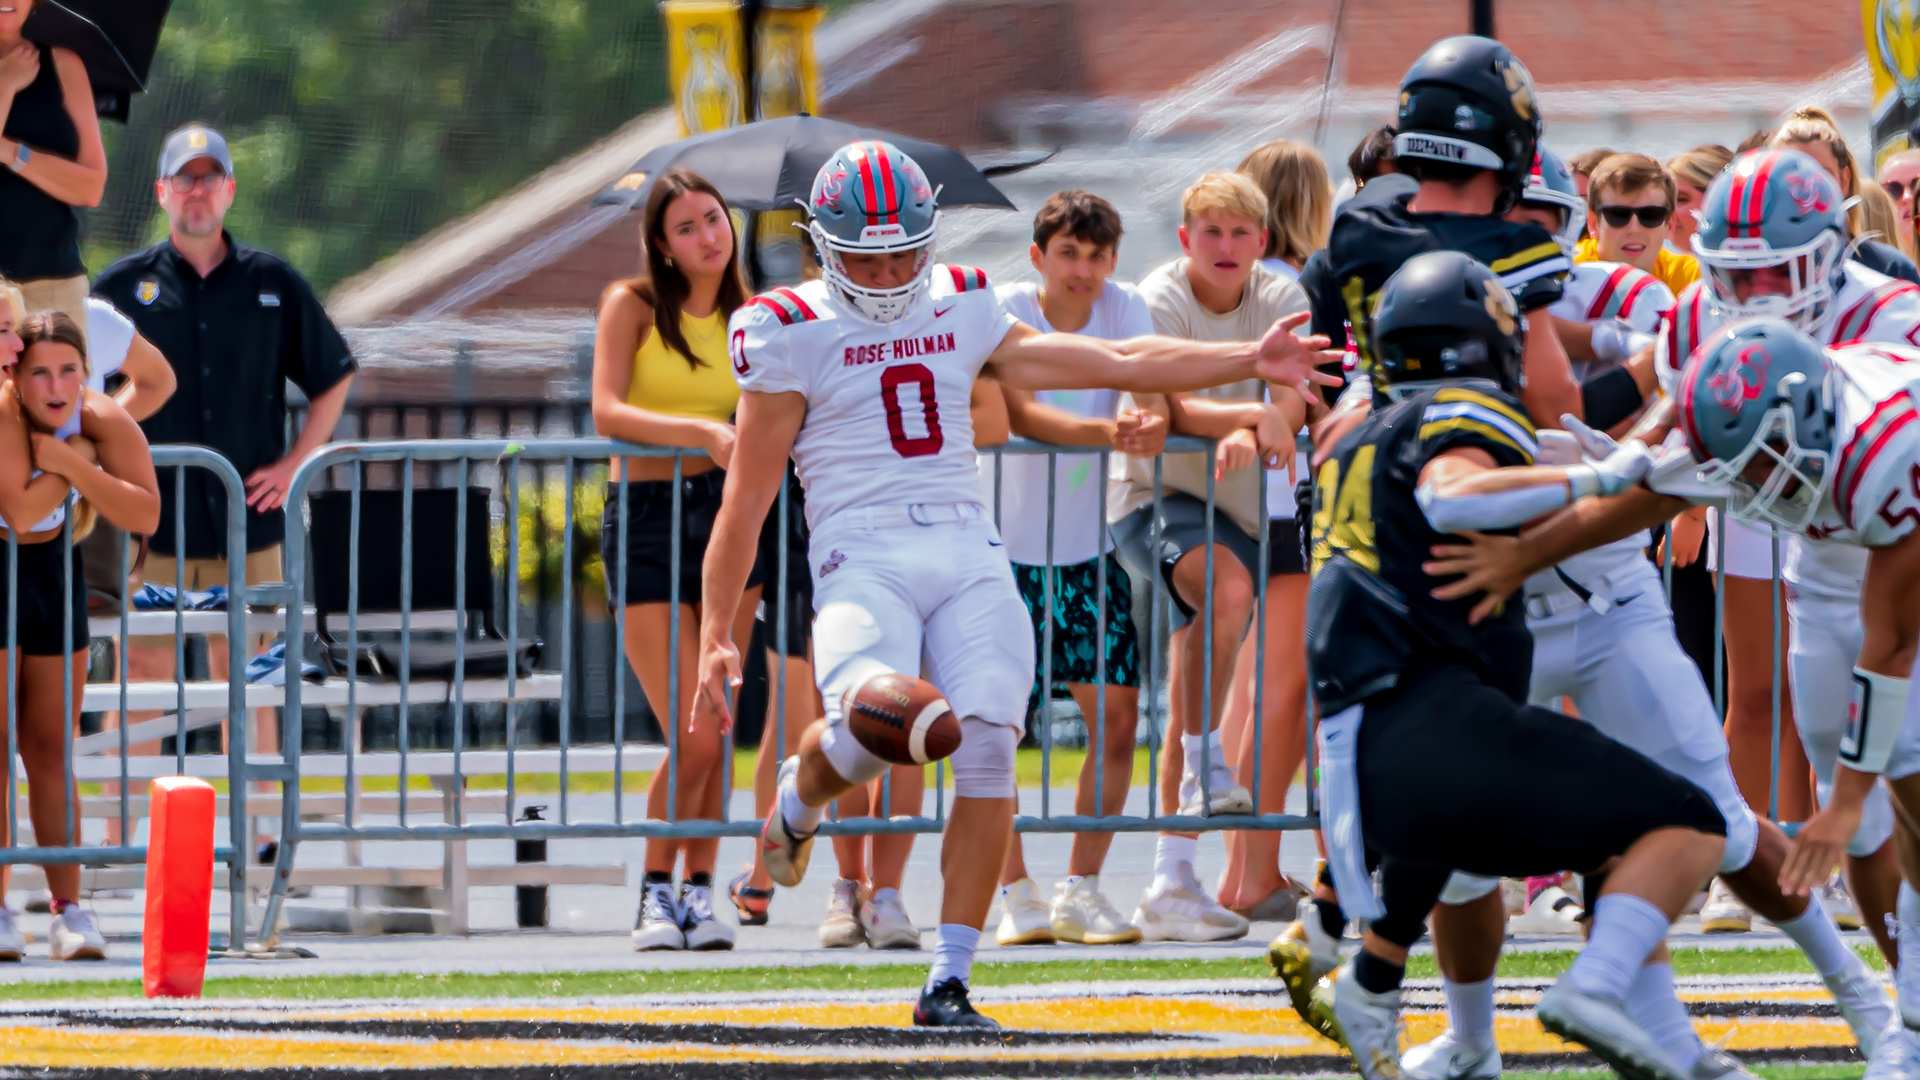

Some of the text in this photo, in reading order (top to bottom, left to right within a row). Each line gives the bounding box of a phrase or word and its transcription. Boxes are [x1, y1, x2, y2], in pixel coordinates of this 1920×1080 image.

[733, 327, 752, 375] 0
[843, 332, 956, 367] ROSE-HULMAN
[880, 362, 943, 460] 0
